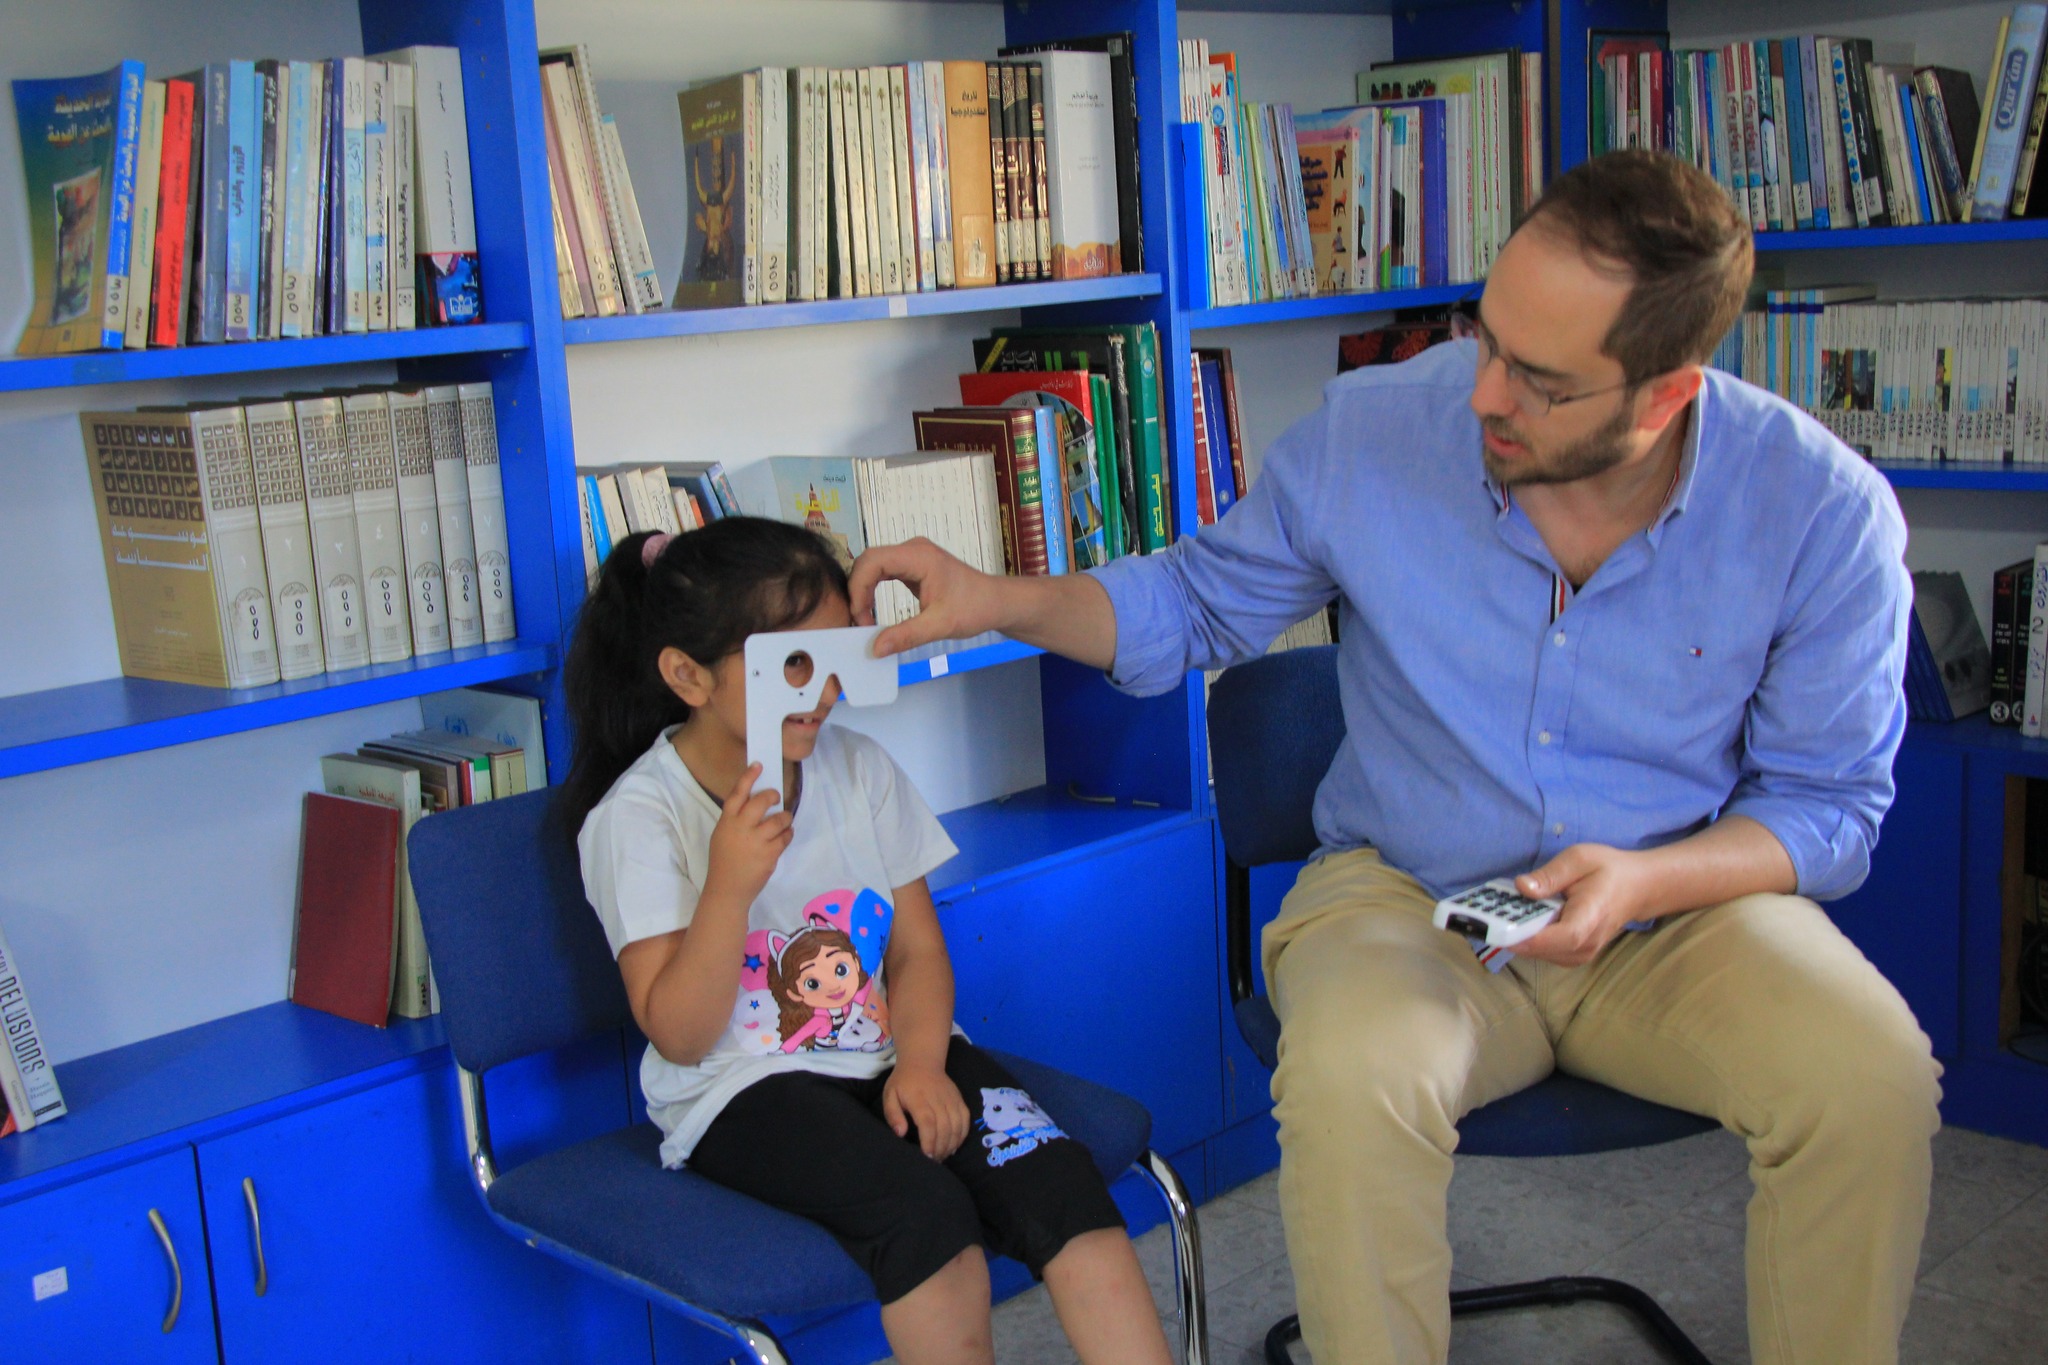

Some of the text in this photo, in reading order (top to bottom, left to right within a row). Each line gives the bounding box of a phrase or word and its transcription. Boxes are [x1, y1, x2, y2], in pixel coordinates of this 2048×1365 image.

[768, 255, 779, 291] 200
[793, 487, 841, 517] الناصرة
[1994, 703, 2007, 721] 3
[0, 976, 45, 1074] DELUSIONS
[986, 1136, 1039, 1168] Sprinkle
